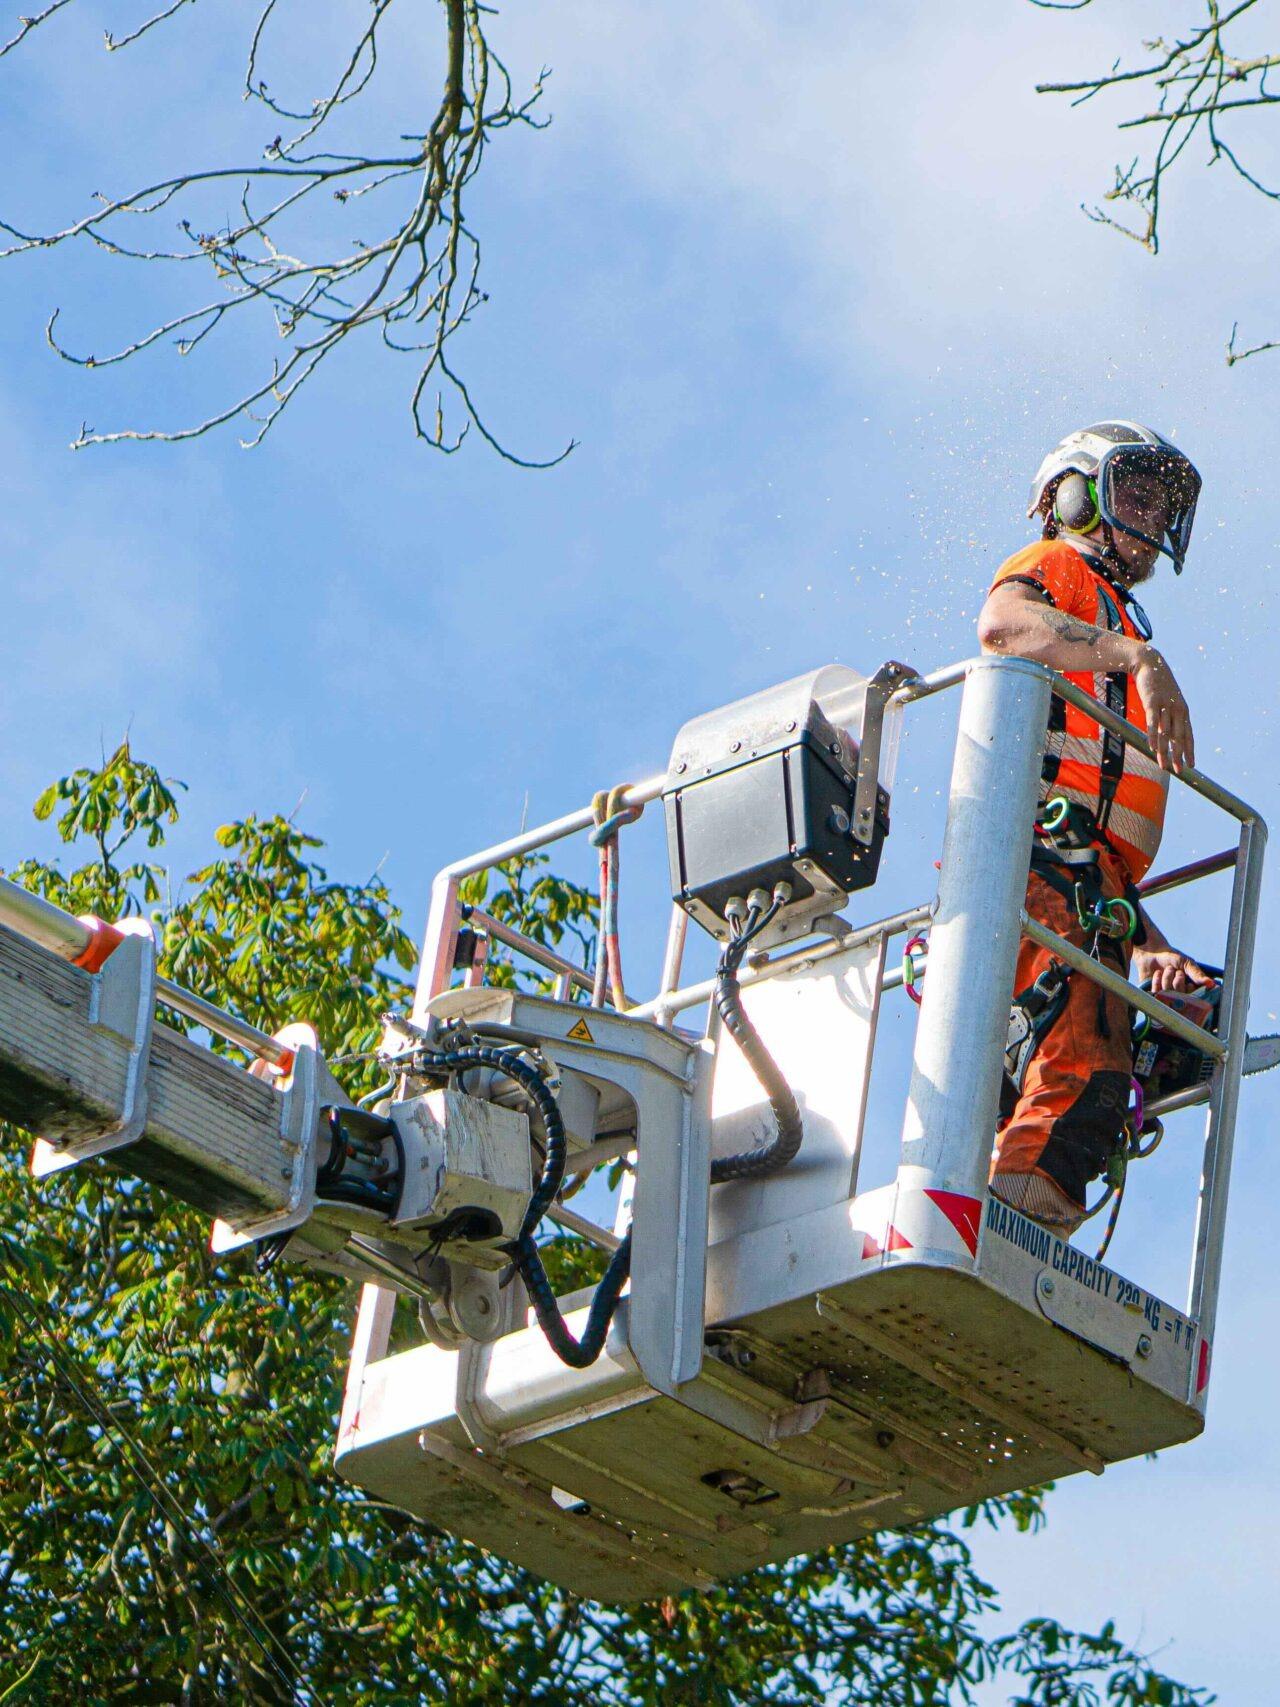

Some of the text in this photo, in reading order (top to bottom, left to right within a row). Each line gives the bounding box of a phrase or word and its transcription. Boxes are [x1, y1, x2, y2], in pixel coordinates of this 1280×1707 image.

[986, 1198, 1051, 1264] MAXIMUM
[1052, 1240, 1112, 1297] CAPACITY
[1144, 1296, 1160, 1332] KG
